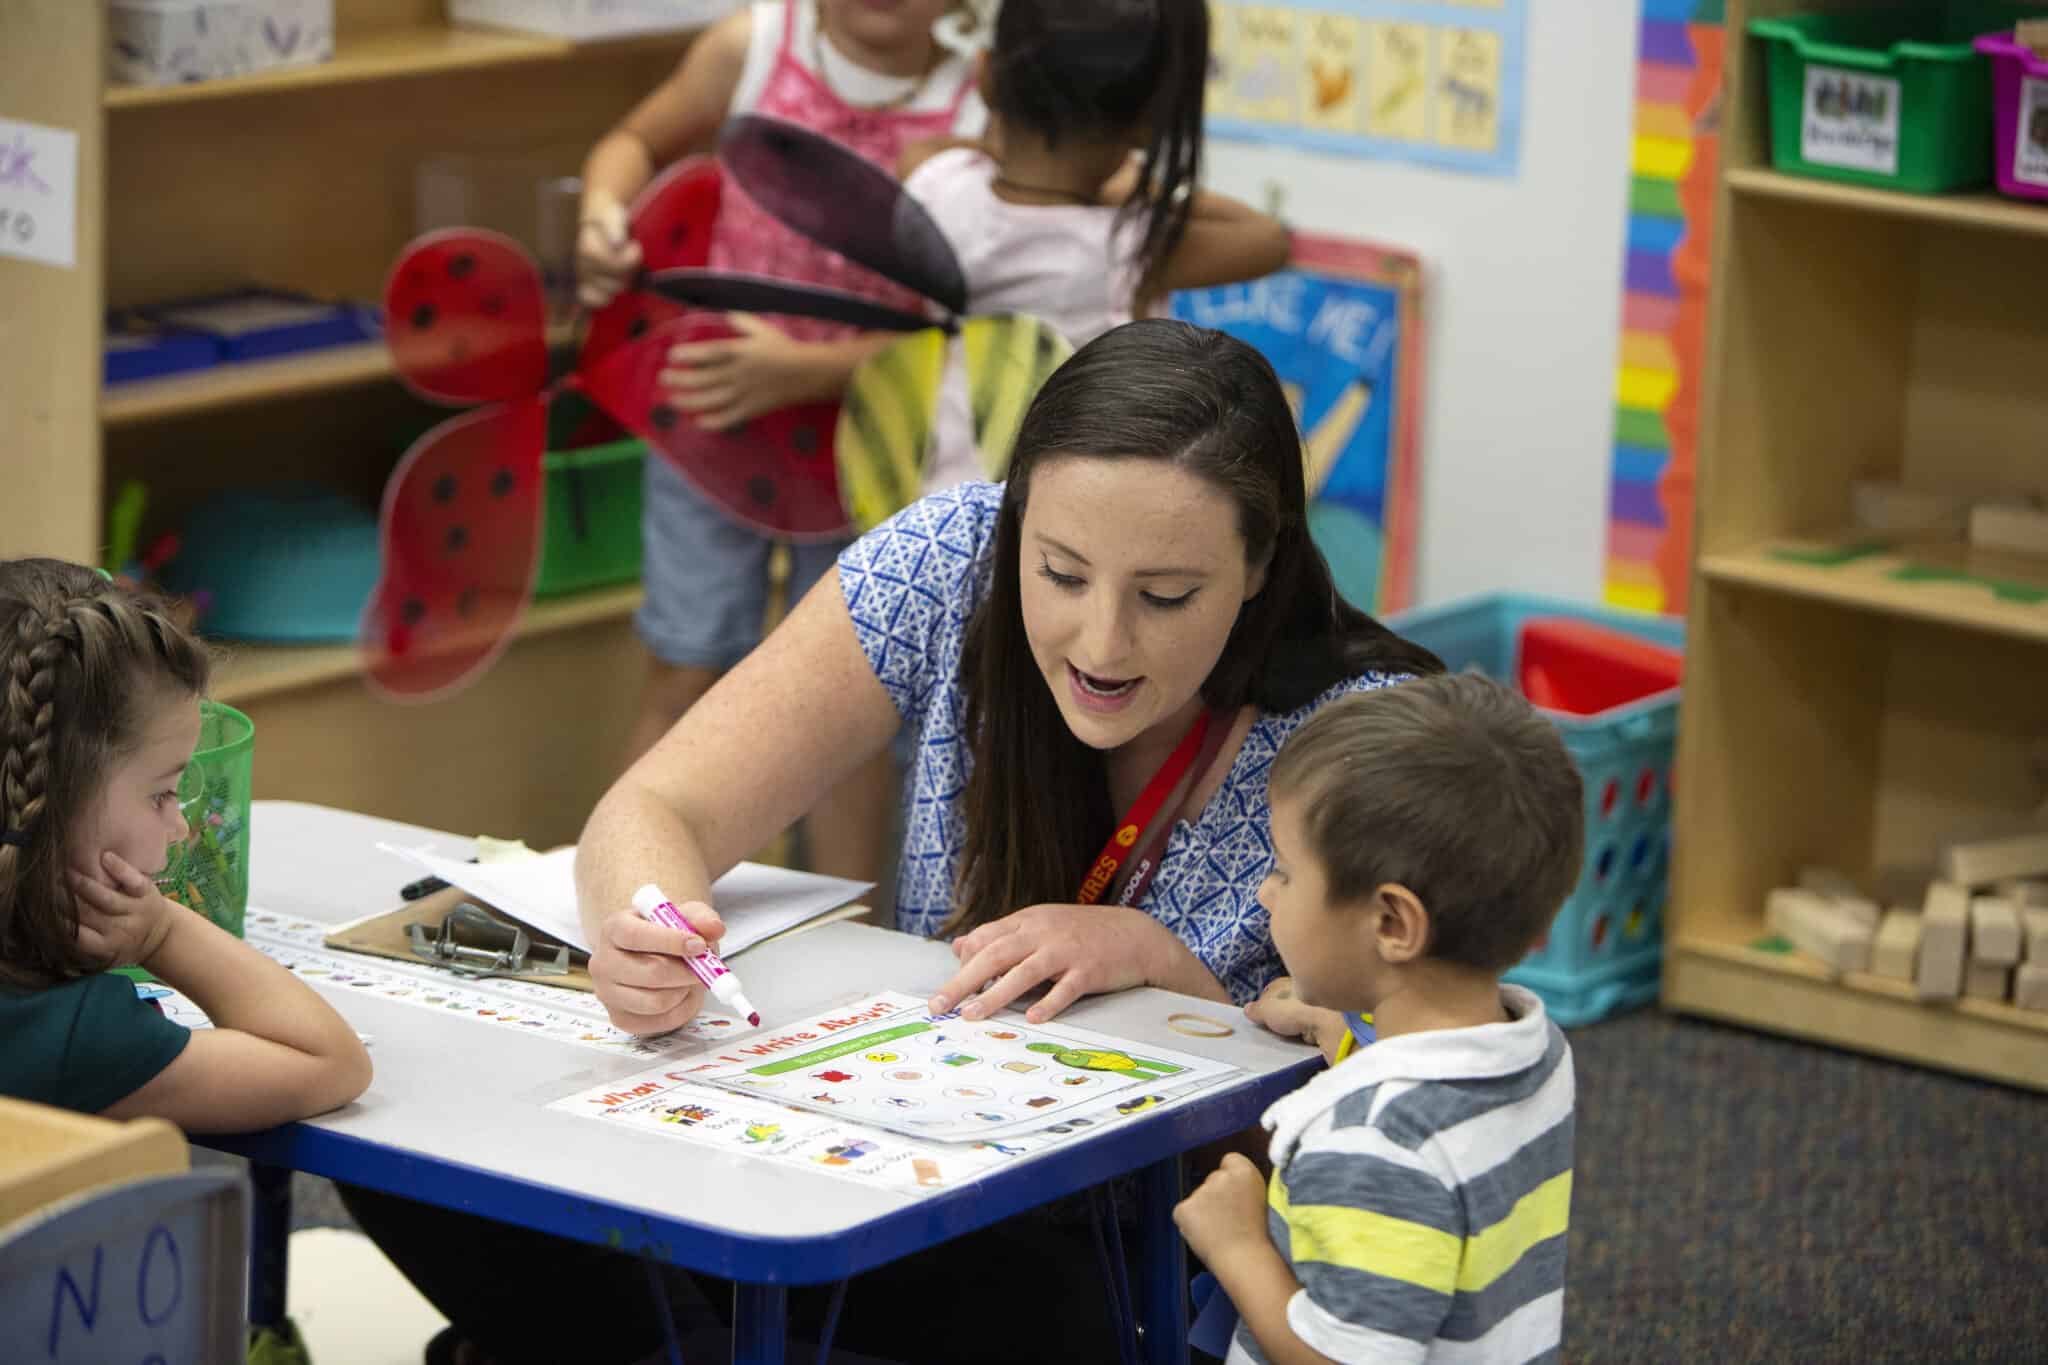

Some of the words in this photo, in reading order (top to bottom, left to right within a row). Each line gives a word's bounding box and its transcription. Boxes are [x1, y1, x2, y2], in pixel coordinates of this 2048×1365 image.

[1077, 855, 1118, 904] IRES
[588, 1080, 665, 1107] What
[718, 1055, 745, 1064] I
[739, 1031, 818, 1056] Write
[817, 1001, 901, 1032] About?
